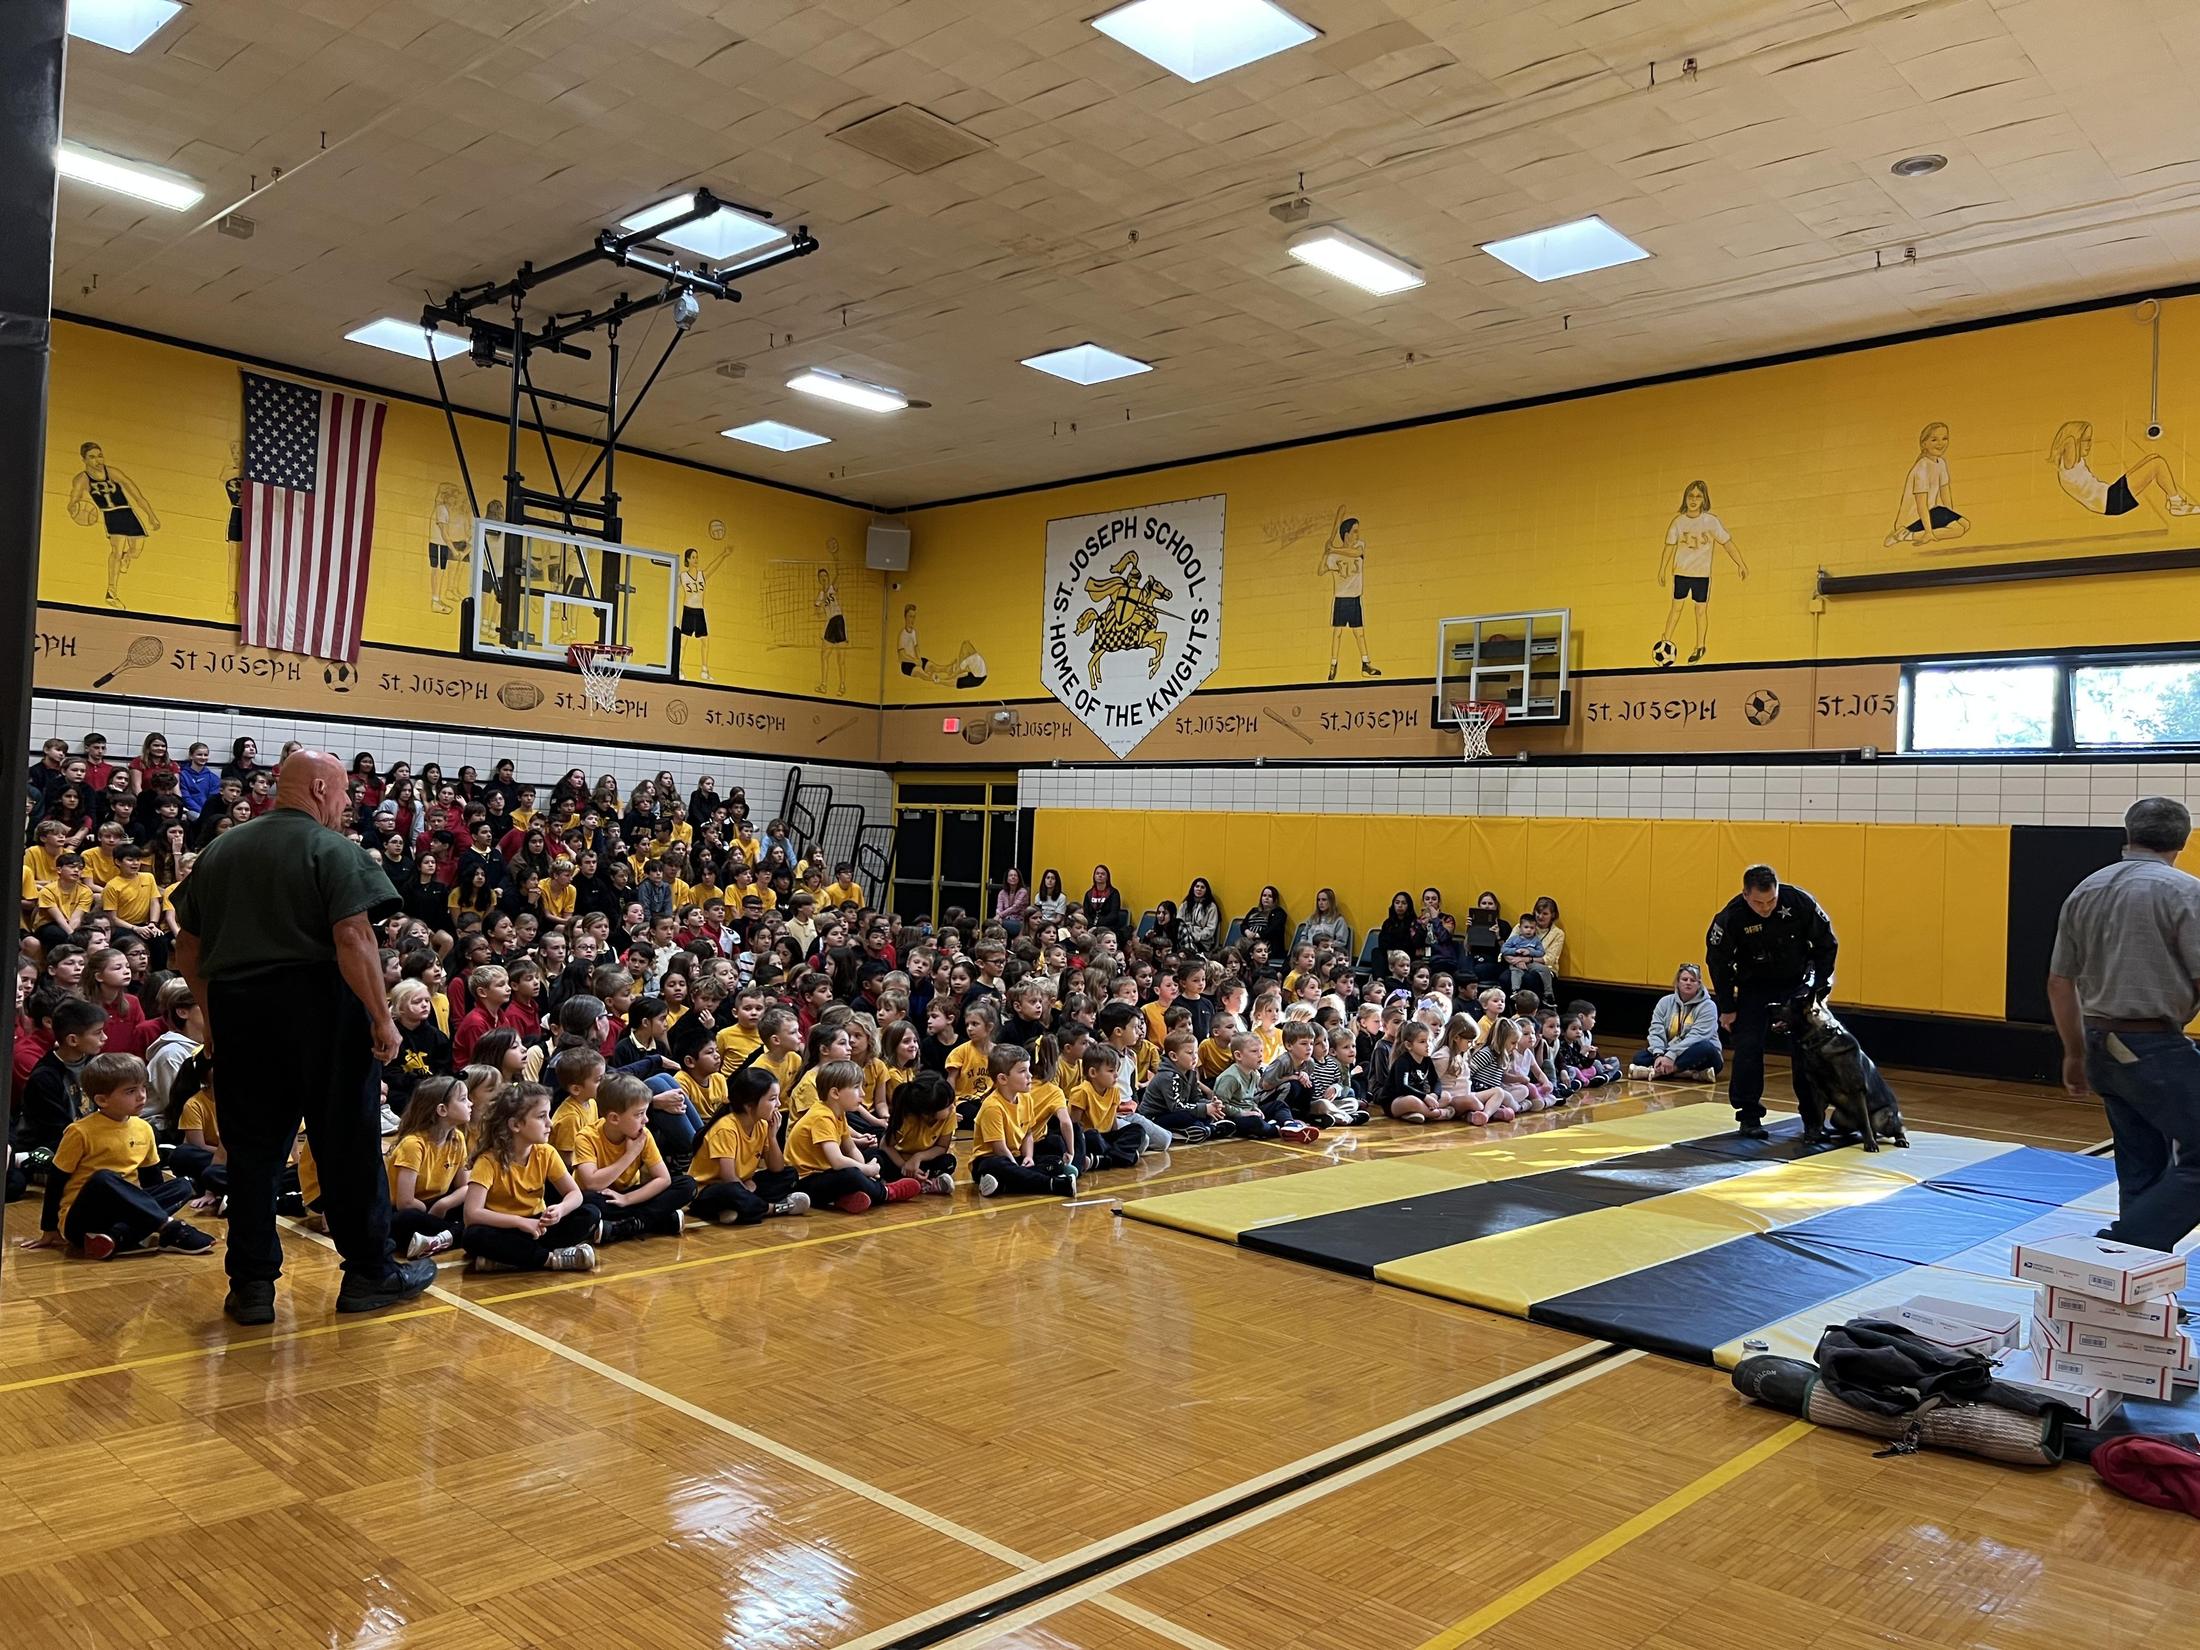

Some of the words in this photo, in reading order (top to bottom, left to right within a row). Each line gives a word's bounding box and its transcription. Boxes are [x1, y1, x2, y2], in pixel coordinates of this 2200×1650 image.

[1053, 582, 1074, 613] ST.
[1069, 516, 1137, 582] JOSEPH
[1144, 517, 1206, 598] SCHOOL
[204, 651, 301, 683] JOSEPH
[1050, 623, 1080, 696] HOME
[1075, 689, 1101, 717] OF
[1104, 703, 1143, 727] THE
[1146, 608, 1209, 717] KNIGHTS
[410, 674, 488, 701] JOSEPH
[726, 710, 786, 735] JOSEPH
[1194, 715, 1258, 736] JOSEPH
[1341, 709, 1418, 736] JOSEPH
[1617, 698, 1717, 728] JOSEPH
[1022, 721, 1072, 741] JOSEPH
